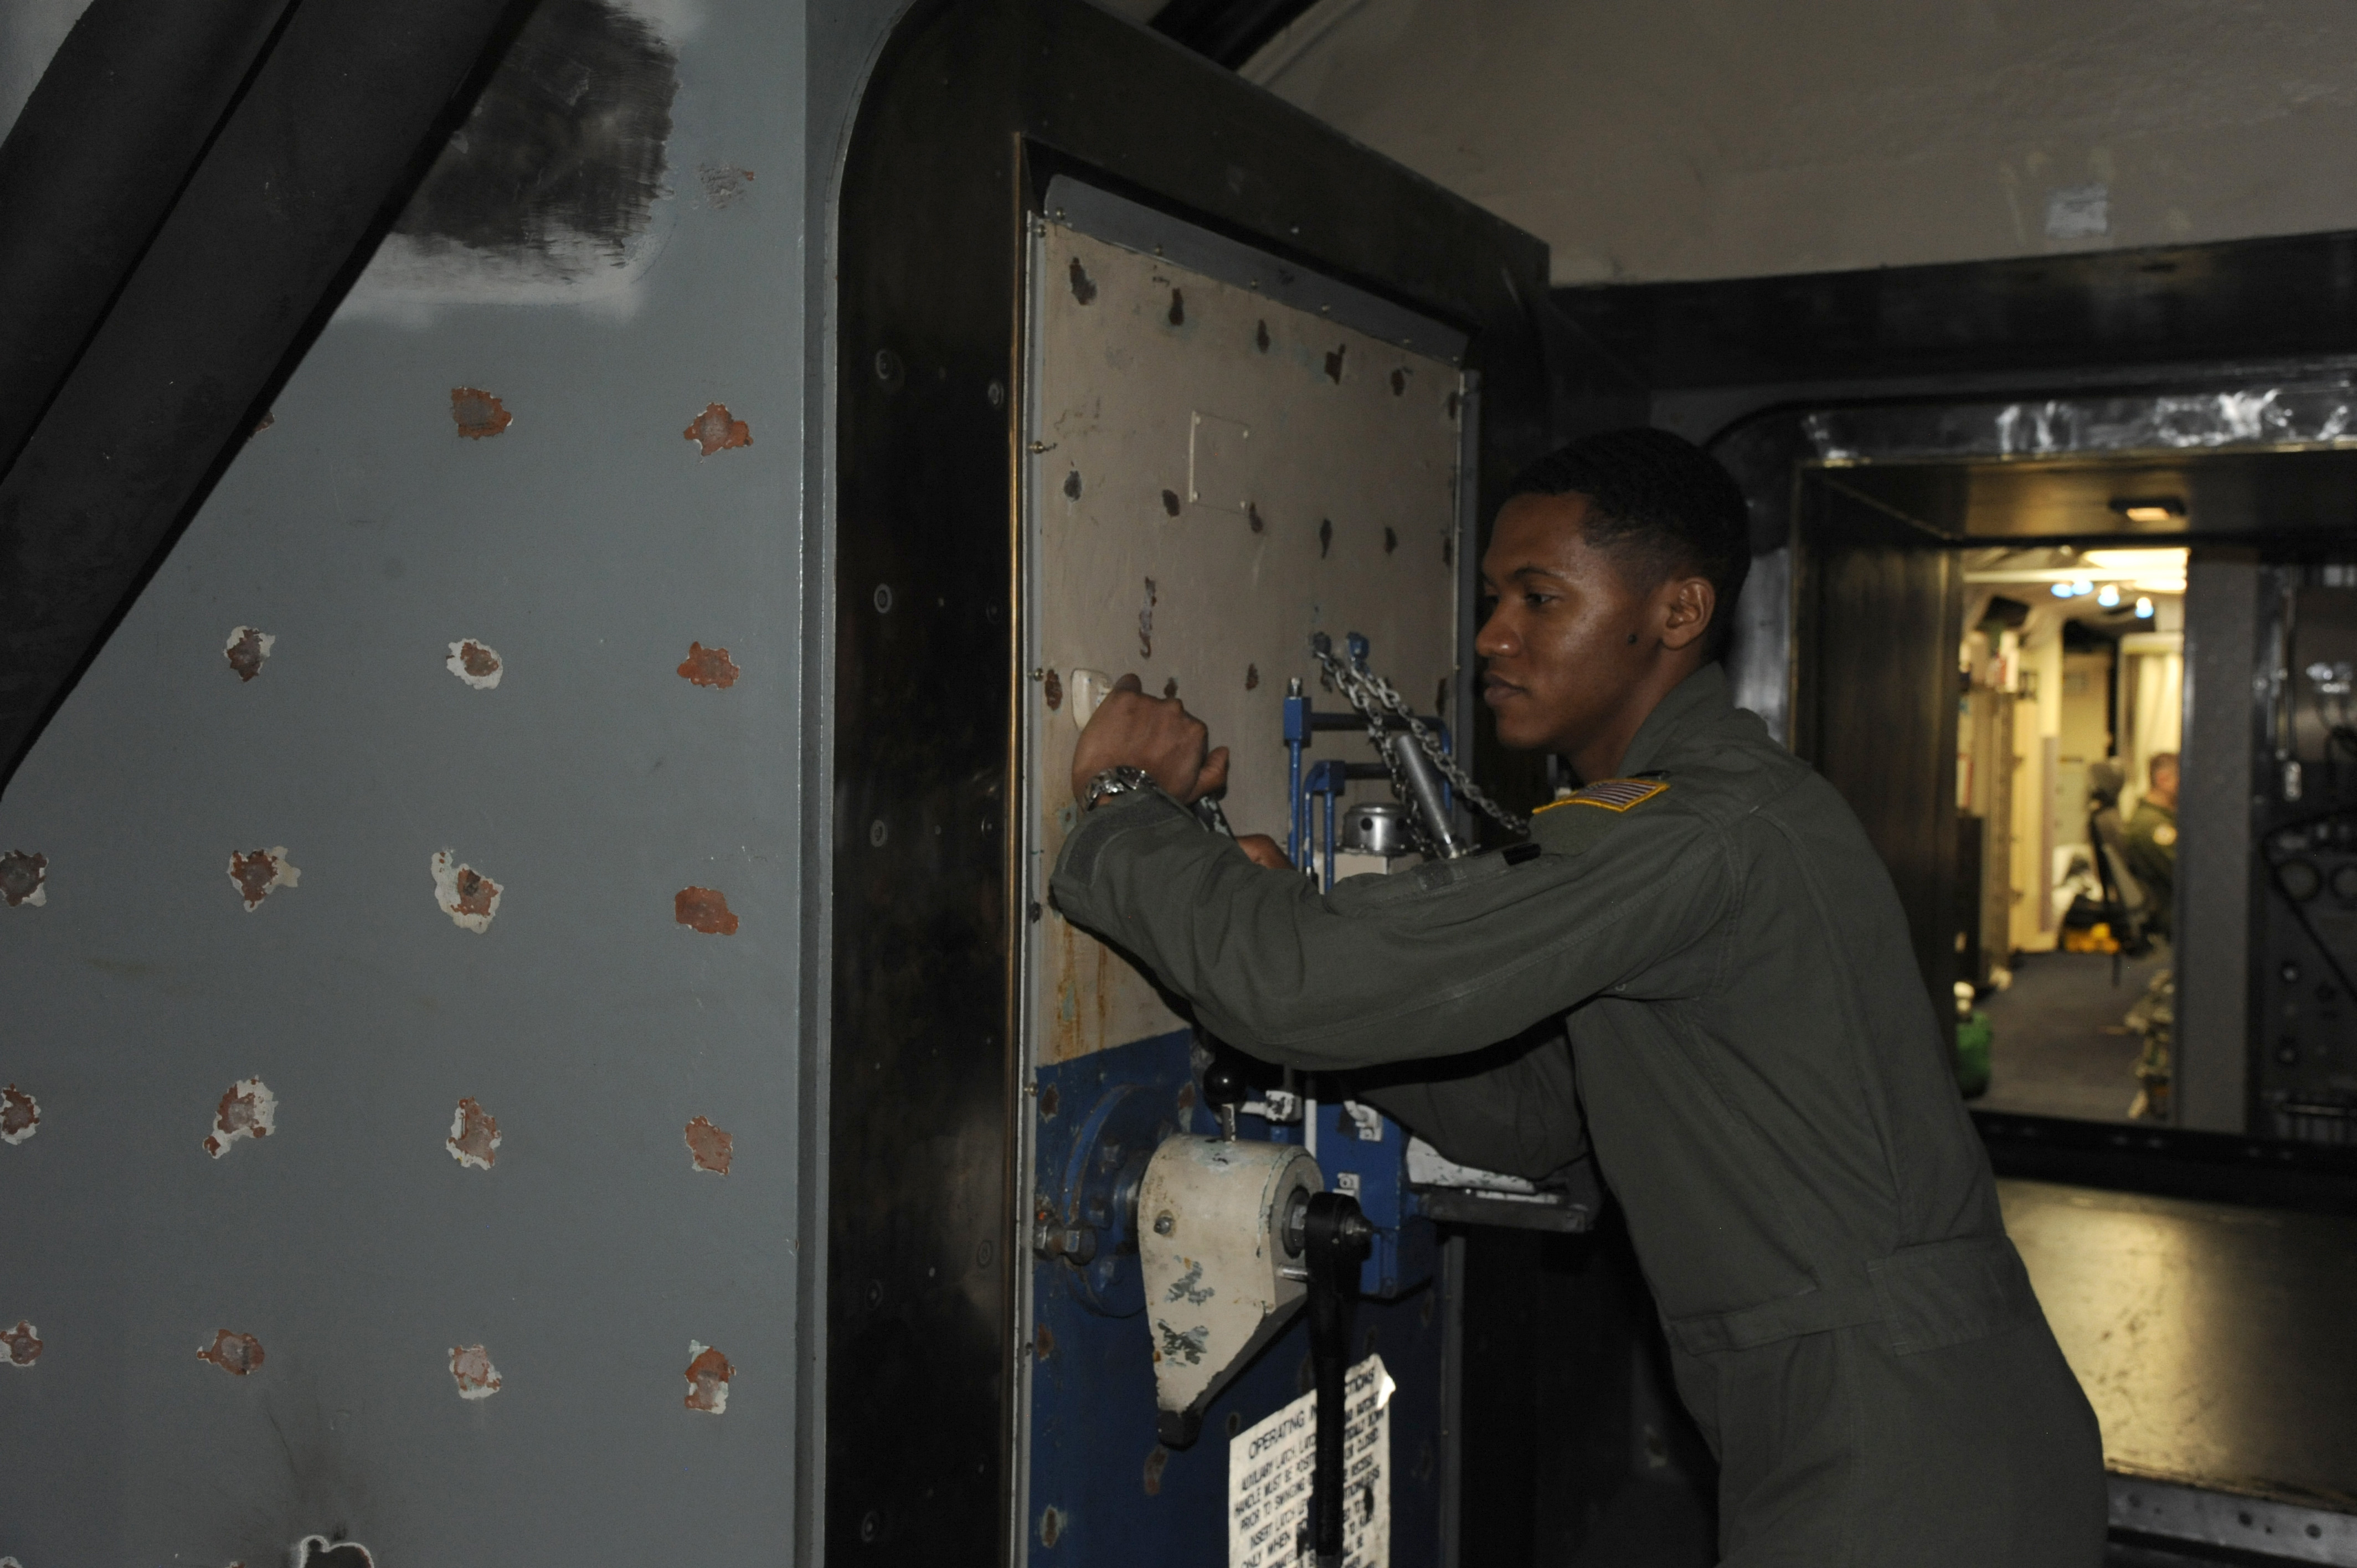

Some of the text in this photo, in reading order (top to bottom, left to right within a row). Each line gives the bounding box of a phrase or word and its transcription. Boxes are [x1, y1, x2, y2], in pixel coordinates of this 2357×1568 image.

[1249, 1411, 1304, 1459] OPERATING
[1265, 1472, 1282, 1496] MUST
[1285, 1467, 1292, 1483] BE
[1241, 1509, 1260, 1533] PRIOR
[1264, 1500, 1270, 1517] TO
[1275, 1477, 1305, 1510] SWINGING
[1250, 1522, 1273, 1550] INSERT
[1267, 1530, 1291, 1556] WHEN
